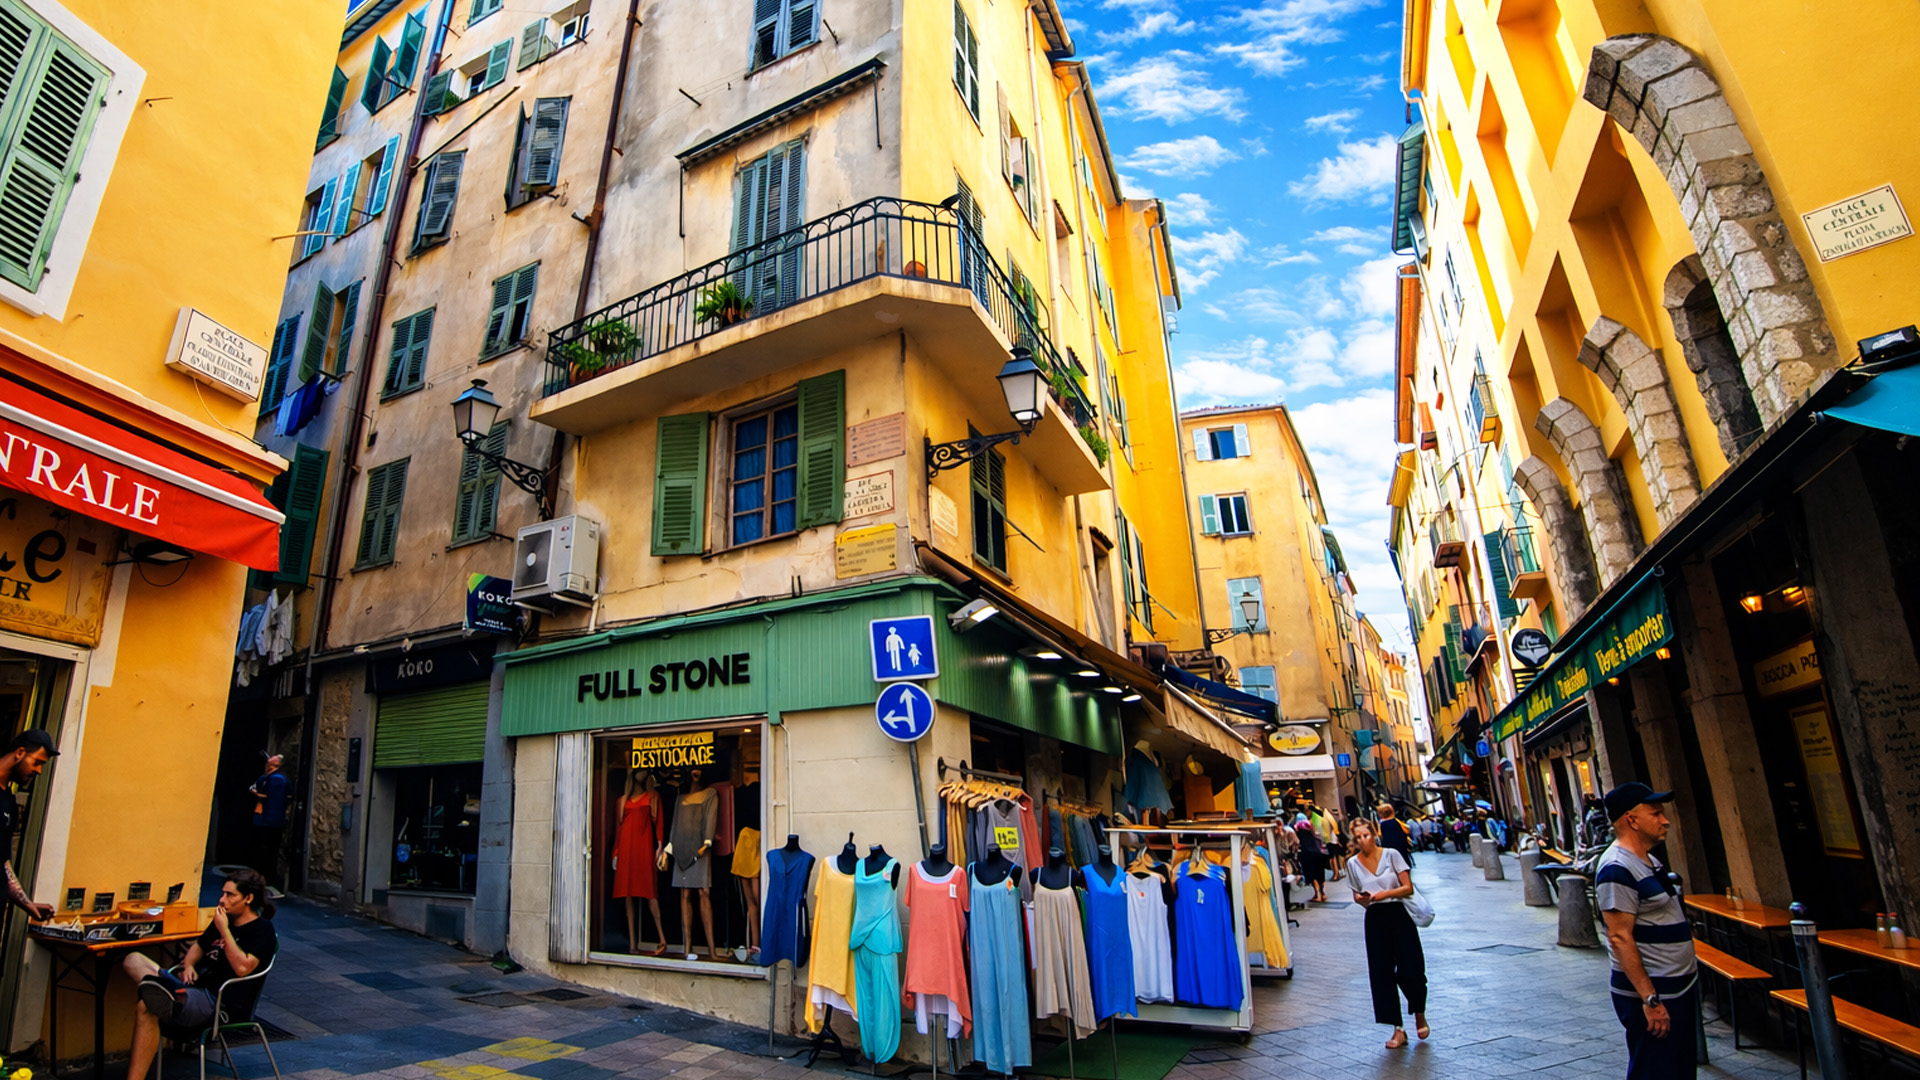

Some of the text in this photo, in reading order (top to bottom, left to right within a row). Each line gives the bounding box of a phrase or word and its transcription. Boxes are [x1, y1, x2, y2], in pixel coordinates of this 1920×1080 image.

[478, 590, 513, 606] KOKO
[578, 652, 751, 703] FULL STONE
